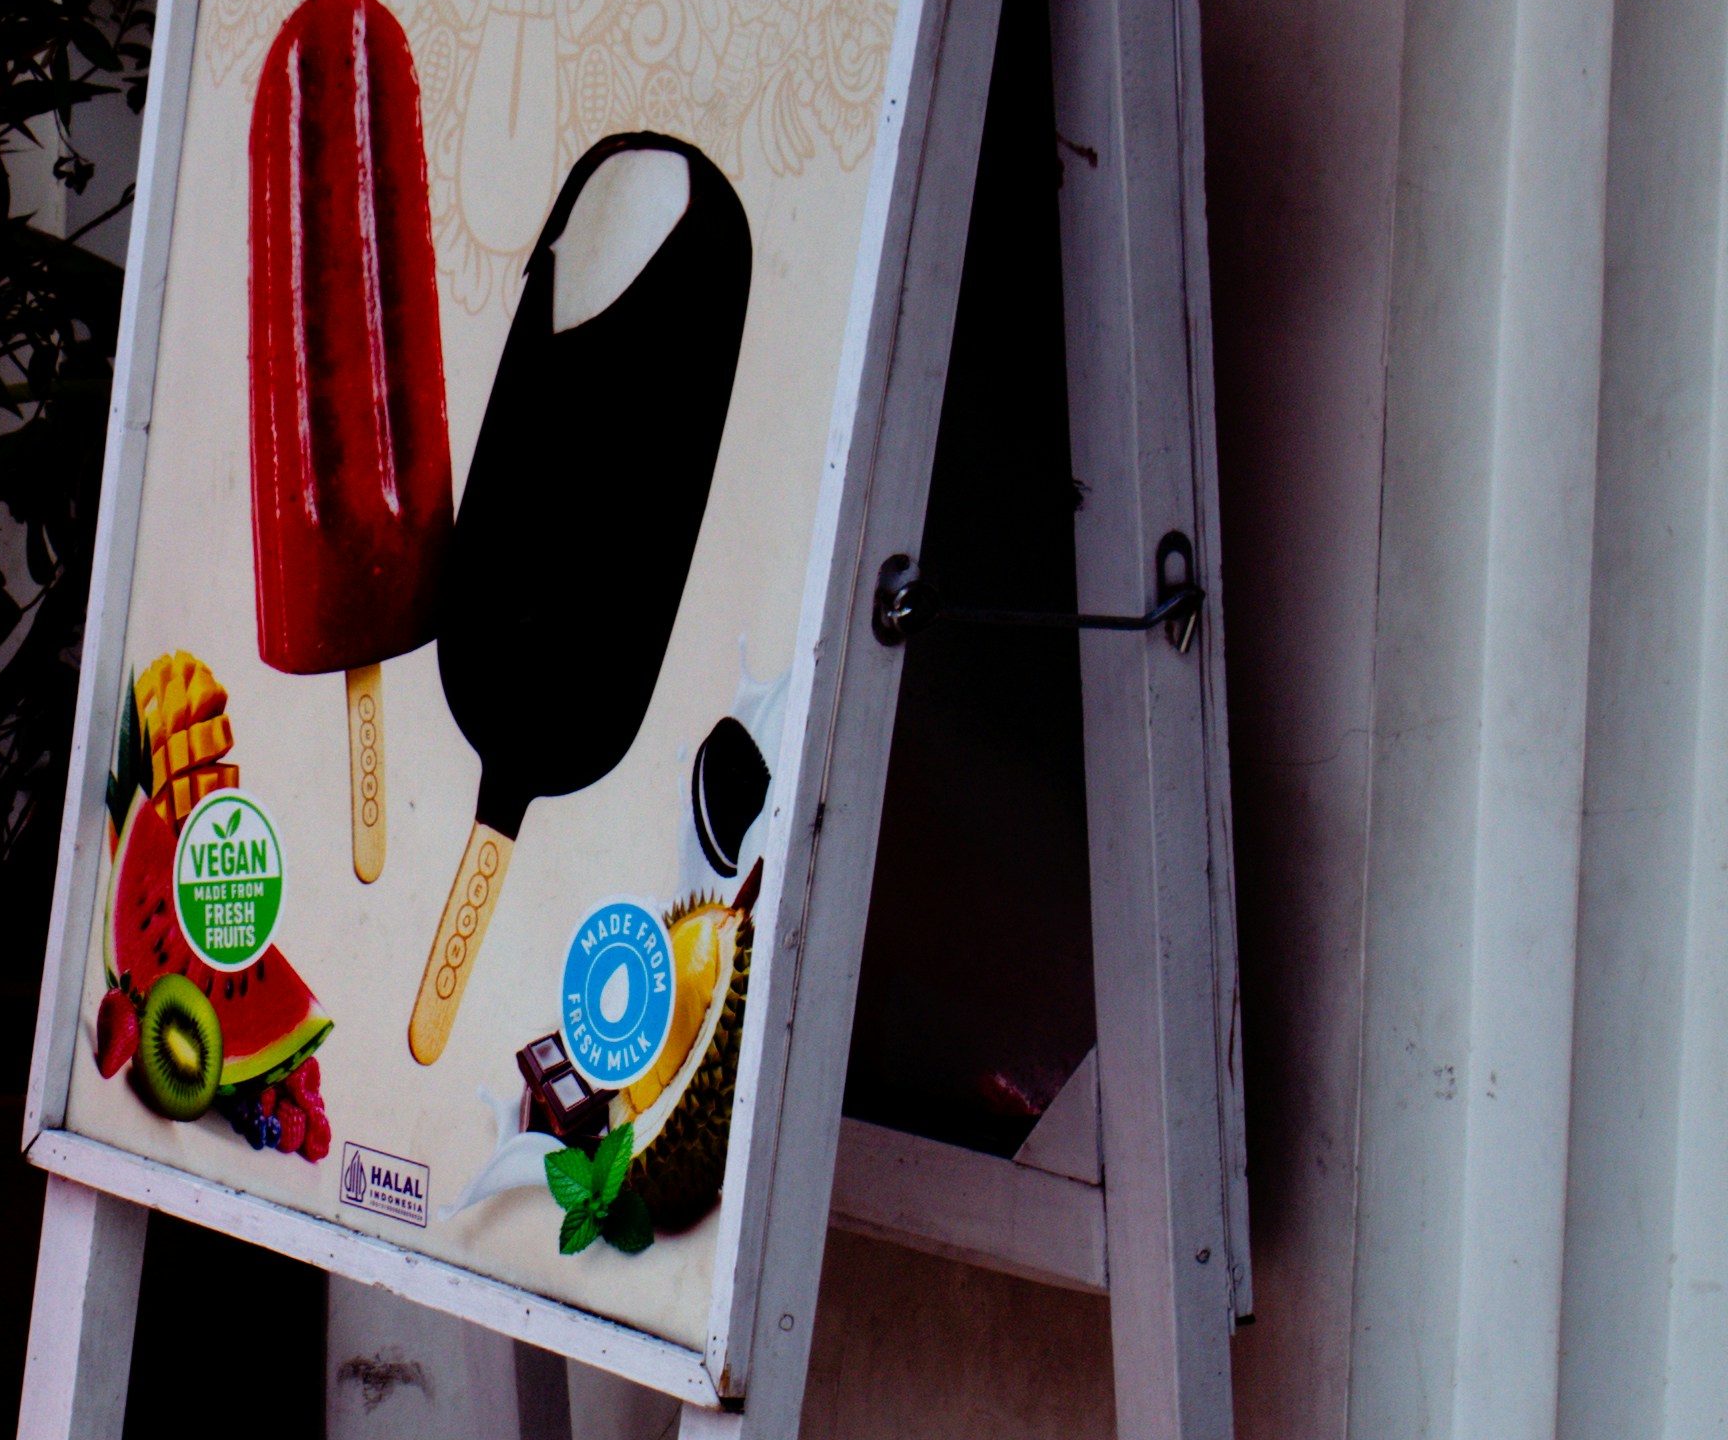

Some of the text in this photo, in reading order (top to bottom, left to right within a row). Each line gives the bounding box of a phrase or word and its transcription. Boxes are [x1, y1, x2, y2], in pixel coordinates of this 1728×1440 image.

[190, 838, 267, 879] VEGAN
[193, 881, 264, 902] MADE FROM
[205, 901, 256, 927] FRESH
[205, 924, 256, 950] FRUITS
[580, 913, 667, 994] MADE FROM
[567, 993, 652, 1072] FRESH MILK
[370, 1165, 424, 1200] HALAL
[369, 1189, 423, 1214] INDONESIA
